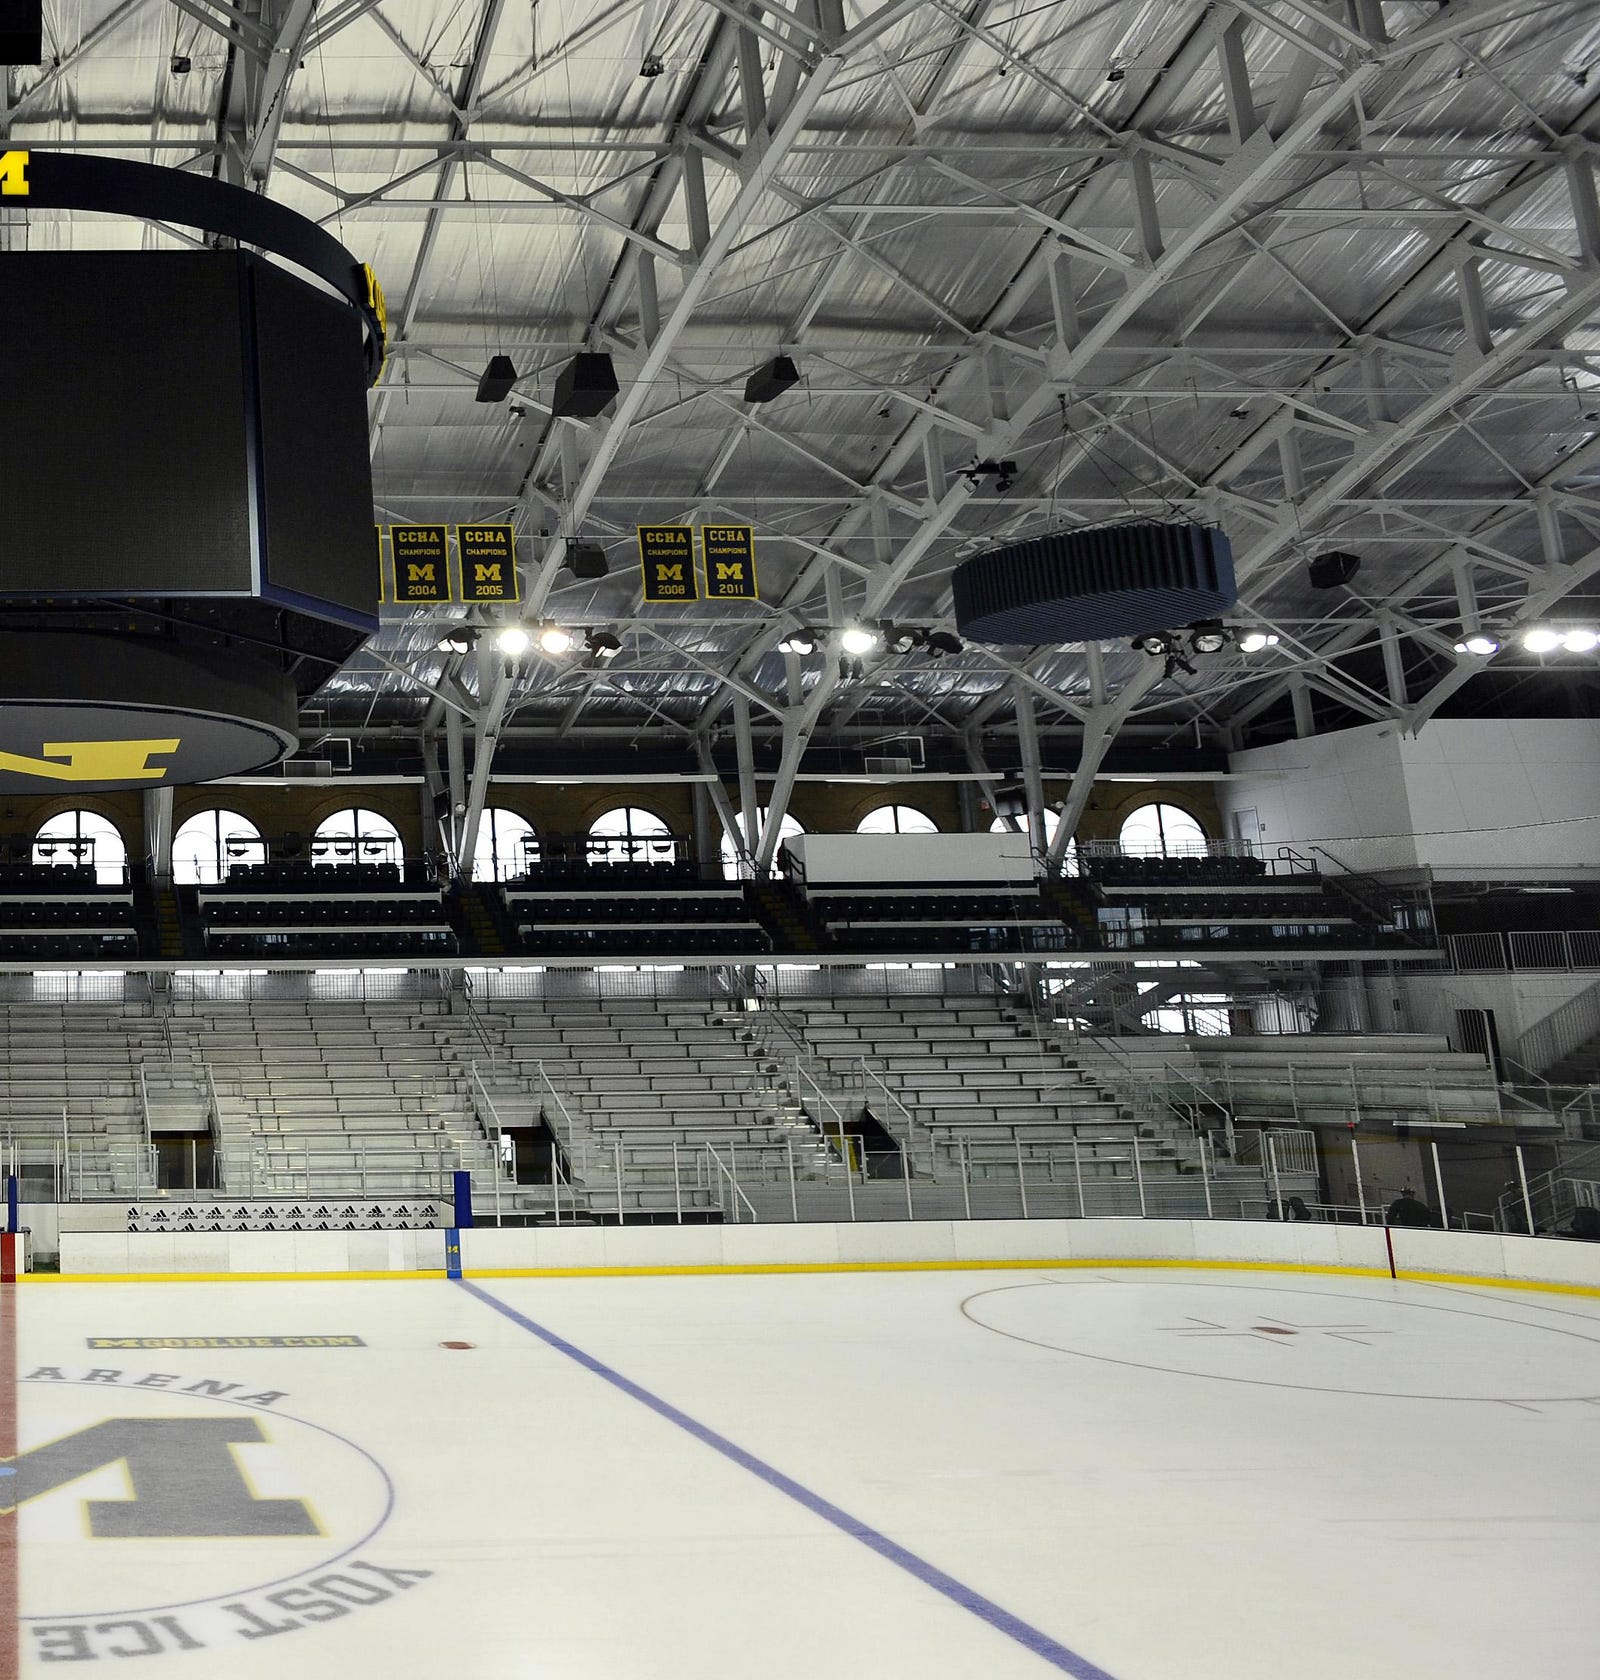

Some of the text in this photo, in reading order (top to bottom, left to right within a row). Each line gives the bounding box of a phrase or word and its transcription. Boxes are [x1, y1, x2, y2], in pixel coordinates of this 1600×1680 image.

[399, 531, 439, 542] CCHA
[465, 531, 506, 542] CCHA
[646, 532, 686, 543] CCHA
[710, 530, 745, 541] CCHA
[408, 564, 435, 581] M
[474, 564, 502, 581] M
[656, 564, 683, 580] M
[716, 563, 743, 579] M
[408, 585, 437, 595] 2004
[476, 585, 503, 595] 2005
[658, 585, 685, 595] 2008
[719, 584, 743, 594] 2011
[92, 1336, 361, 1348] MGOBLUE.COM
[25, 1366, 291, 1406] ARENA
[221, 1560, 434, 1640] YOST
[32, 1615, 206, 1662] ICE
